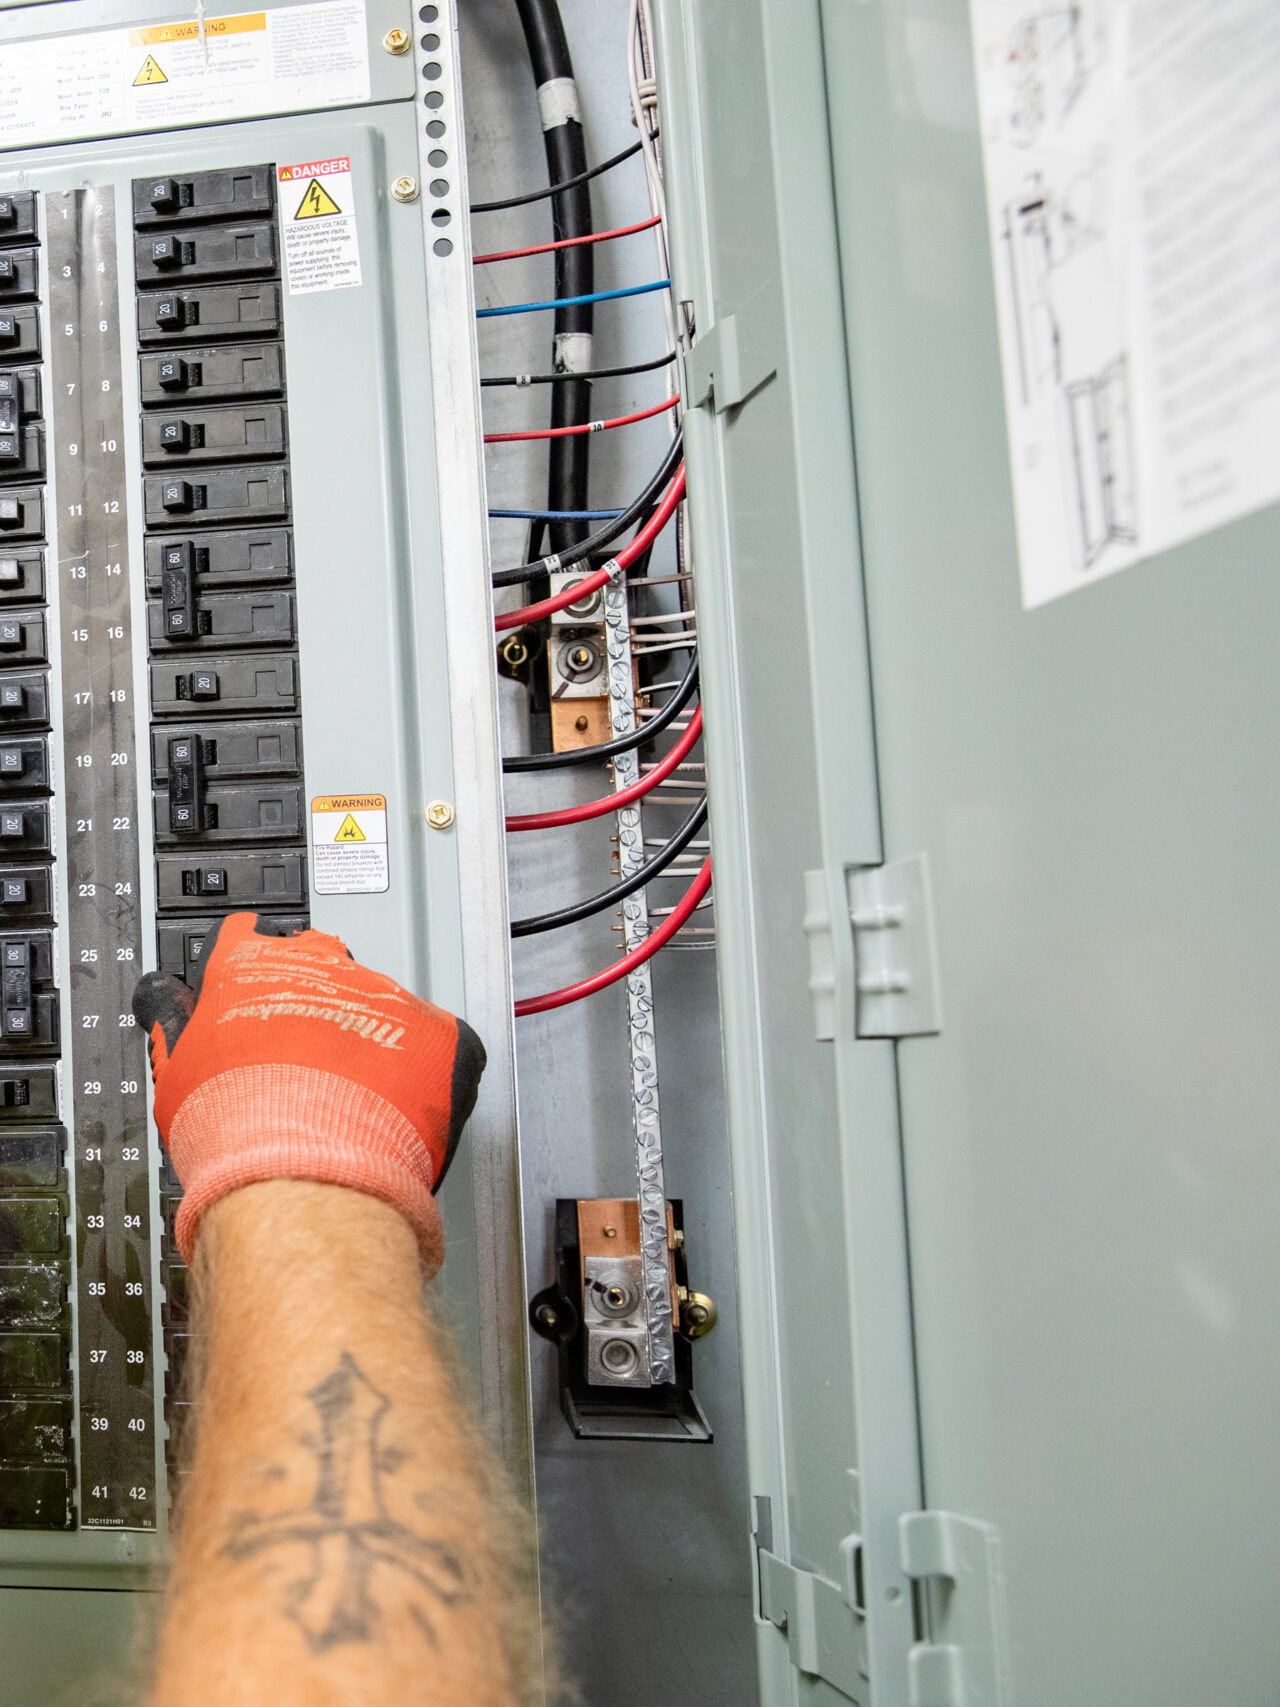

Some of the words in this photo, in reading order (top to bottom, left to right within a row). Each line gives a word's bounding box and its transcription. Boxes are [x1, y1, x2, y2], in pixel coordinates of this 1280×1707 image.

[292, 159, 349, 178] DANGER
[154, 185, 165, 197] 20
[61, 208, 68, 219] 1
[94, 204, 103, 216] 2
[285, 224, 321, 233] HAZARDOUS
[322, 220, 348, 228] VOLTAGE
[155, 243, 166, 255] 20
[287, 241, 301, 249] death
[309, 237, 329, 247] property
[62, 265, 72, 278] 3
[96, 262, 105, 273] 4
[289, 265, 316, 274] equipment
[317, 262, 333, 270] before
[334, 259, 357, 269] removing
[290, 274, 307, 282] covers
[315, 270, 334, 279] working
[159, 303, 170, 315] 20
[64, 323, 74, 336] 5
[99, 320, 108, 332] 6
[161, 364, 173, 376] 20
[66, 383, 76, 395] 7
[101, 379, 111, 392] 8
[165, 426, 176, 437] 20
[593, 424, 602, 432] 10
[0, 440, 11, 452] 60
[69, 443, 78, 456] 9
[100, 439, 117, 453] 10
[167, 488, 178, 499] 20
[68, 504, 82, 517] 11
[103, 500, 120, 514] 12
[169, 552, 181, 564] 60
[69, 566, 86, 579] 13
[105, 563, 122, 576] 14
[171, 614, 183, 625] 60
[3, 627, 16, 638] 20
[71, 629, 89, 642] 15
[107, 626, 124, 639] 16
[198, 677, 210, 689] 20
[5, 691, 18, 702] 20
[74, 692, 91, 705] 17
[109, 689, 126, 702] 18
[176, 746, 188, 758] 60
[5, 755, 17, 766] 20
[75, 754, 93, 768] 19
[110, 752, 128, 766] 20
[331, 798, 382, 808] WARNING
[177, 809, 189, 820] 60
[6, 819, 19, 830] 20
[77, 819, 93, 832] 21
[112, 817, 130, 830] 22
[207, 873, 219, 884] 20
[8, 884, 21, 896] 20
[78, 883, 96, 897] 23
[114, 882, 132, 895] 24
[7, 949, 19, 961] 30
[80, 949, 98, 962] 25
[116, 947, 134, 961] 26
[12, 1017, 24, 1028] 30
[82, 1015, 100, 1028] 27
[118, 1014, 136, 1027] 28
[216, 1003, 406, 1051] Milwaukee
[84, 1081, 102, 1095] 29
[120, 1080, 138, 1094] 30
[85, 1148, 101, 1161] 31
[122, 1147, 140, 1161] 32
[87, 1215, 105, 1228] 33
[123, 1215, 141, 1228] 34
[88, 1282, 106, 1296] 35
[125, 1282, 143, 1296] 36
[90, 1350, 108, 1363] 37
[126, 1350, 144, 1364] 38
[91, 1417, 109, 1431] 39
[127, 1418, 145, 1432] 40
[91, 1485, 108, 1499] 41
[129, 1486, 146, 1500] 42
